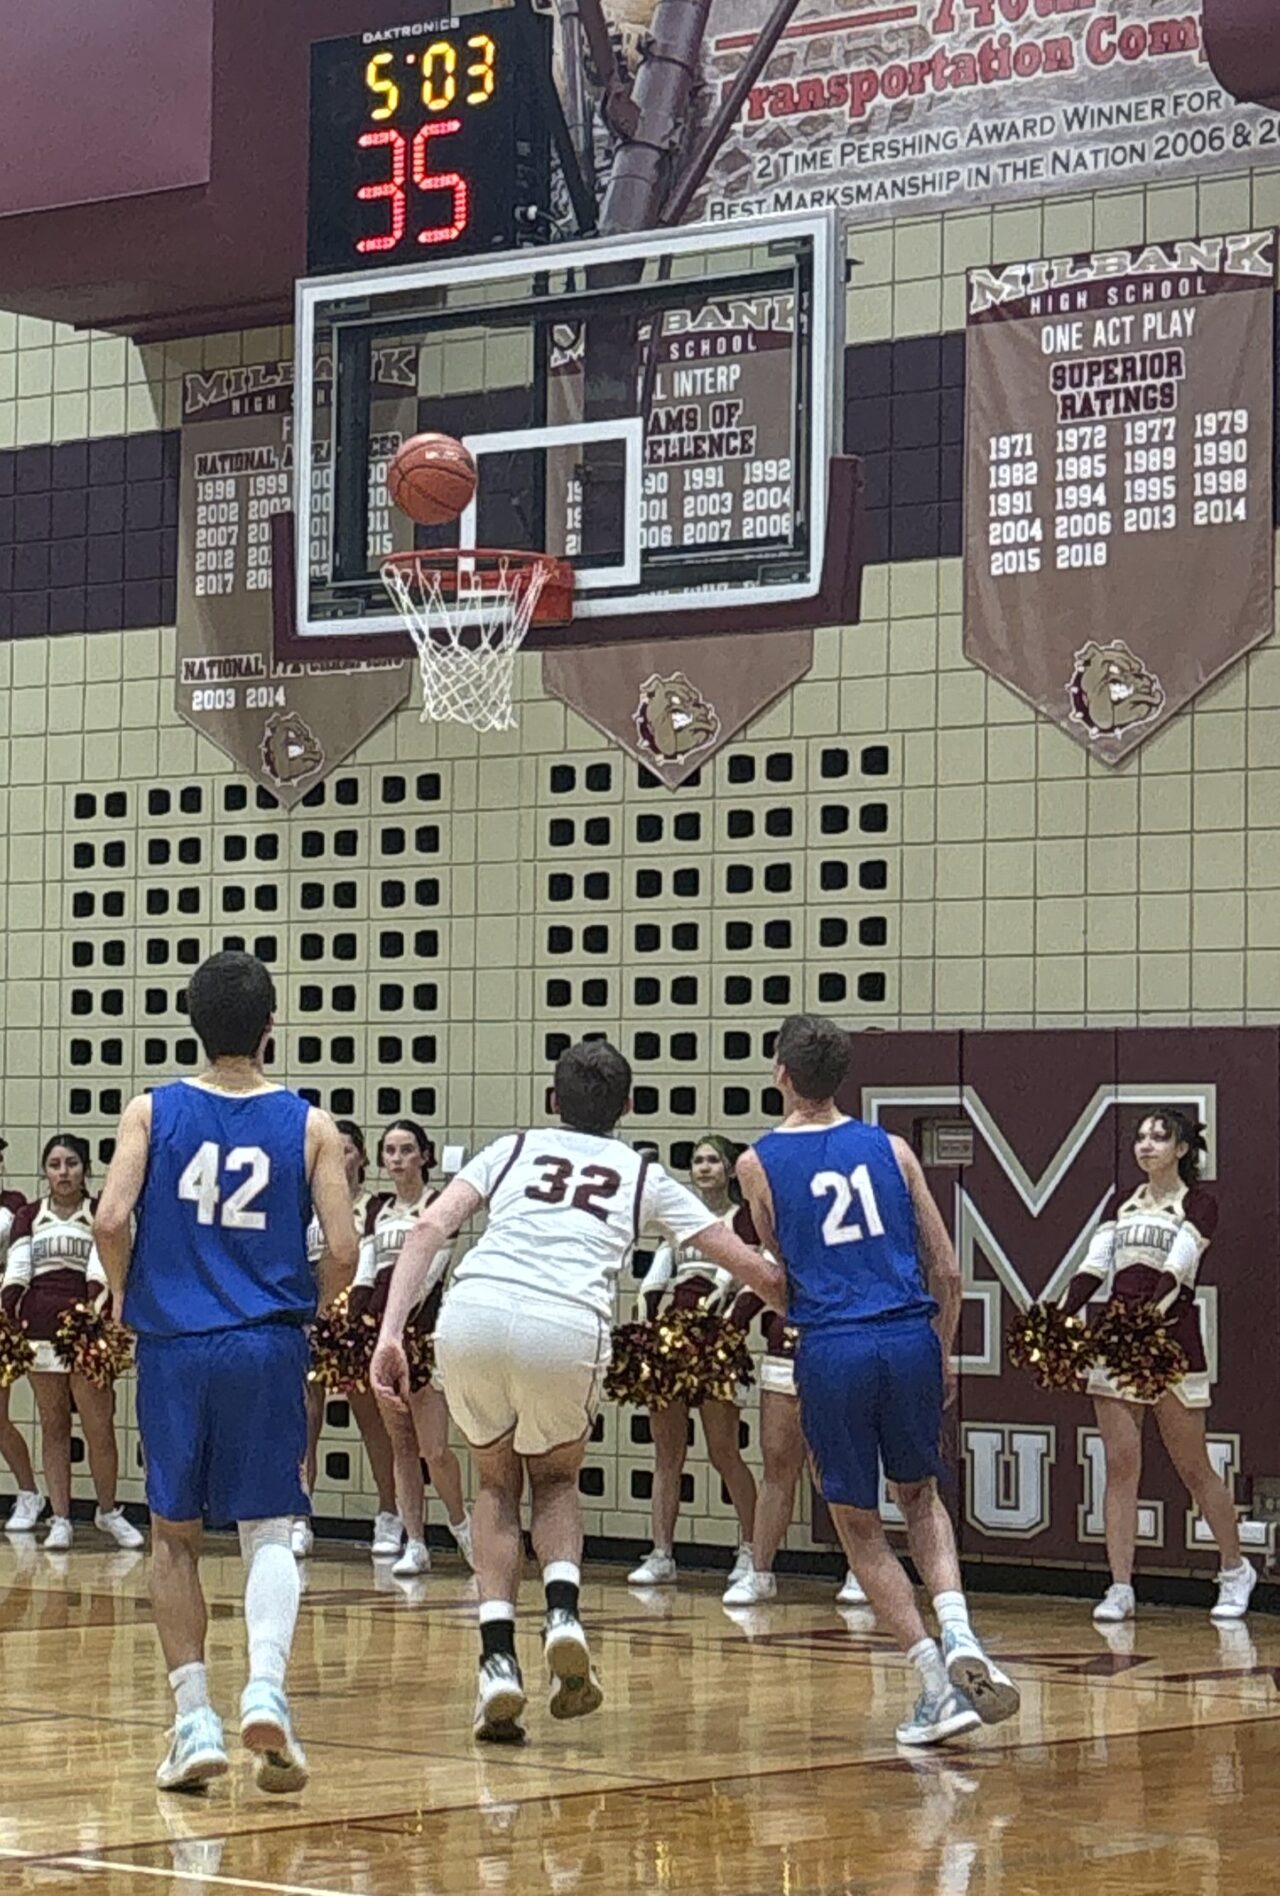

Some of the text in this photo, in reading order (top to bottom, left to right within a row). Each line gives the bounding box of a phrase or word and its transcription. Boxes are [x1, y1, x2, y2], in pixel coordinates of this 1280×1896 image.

[363, 17, 460, 45] DAKTRONICS
[1086, 15, 1209, 66] Com
[840, 129, 959, 167] PERSHING
[966, 114, 1056, 148] AWARD
[1062, 100, 1166, 132] WINNER
[1172, 89, 1222, 117] FOR
[773, 169, 961, 212] MARKSMANSHIP
[967, 165, 991, 188] IN
[997, 157, 1045, 183] THE
[1051, 142, 1146, 176] NATION
[1153, 126, 1225, 161] 2006
[1232, 122, 1252, 149] &
[356, 119, 468, 254] 35
[968, 230, 1275, 316] MILBANK
[1029, 275, 1207, 316] HIGH SCHOOL
[669, 332, 758, 361] SCHOOL
[1040, 306, 1197, 355] ONE ACT PLAY
[672, 363, 742, 399] INTERP
[1050, 348, 1186, 394] SUPERIOR
[231, 394, 276, 416] HIGH
[649, 402, 742, 437] AMS OF
[1057, 381, 1178, 423] RATINGS
[646, 429, 756, 466] ELLENCE
[988, 408, 1249, 462] 1971 1972 1977 1979
[196, 446, 278, 477] NATIONAL
[682, 465, 725, 492] 1991
[742, 458, 792, 486] 1992
[988, 438, 1248, 490] 1982 1985 1989 1990
[682, 491, 733, 519] 2003
[988, 467, 1248, 518] 1991 1994 1995 1998
[196, 501, 240, 526] 2002
[988, 497, 1248, 547] 2004 2006 2013 2014
[195, 524, 239, 550] 2007
[682, 519, 732, 546] 2007
[195, 548, 235, 573] 2012
[990, 547, 1042, 577] 2015
[195, 571, 235, 597] 2017
[182, 654, 265, 683] NATIONAL
[191, 684, 287, 712] 2003 2014
[176, 1138, 273, 1233] 42
[523, 1153, 622, 1222] 32
[808, 1163, 887, 1248] 21
